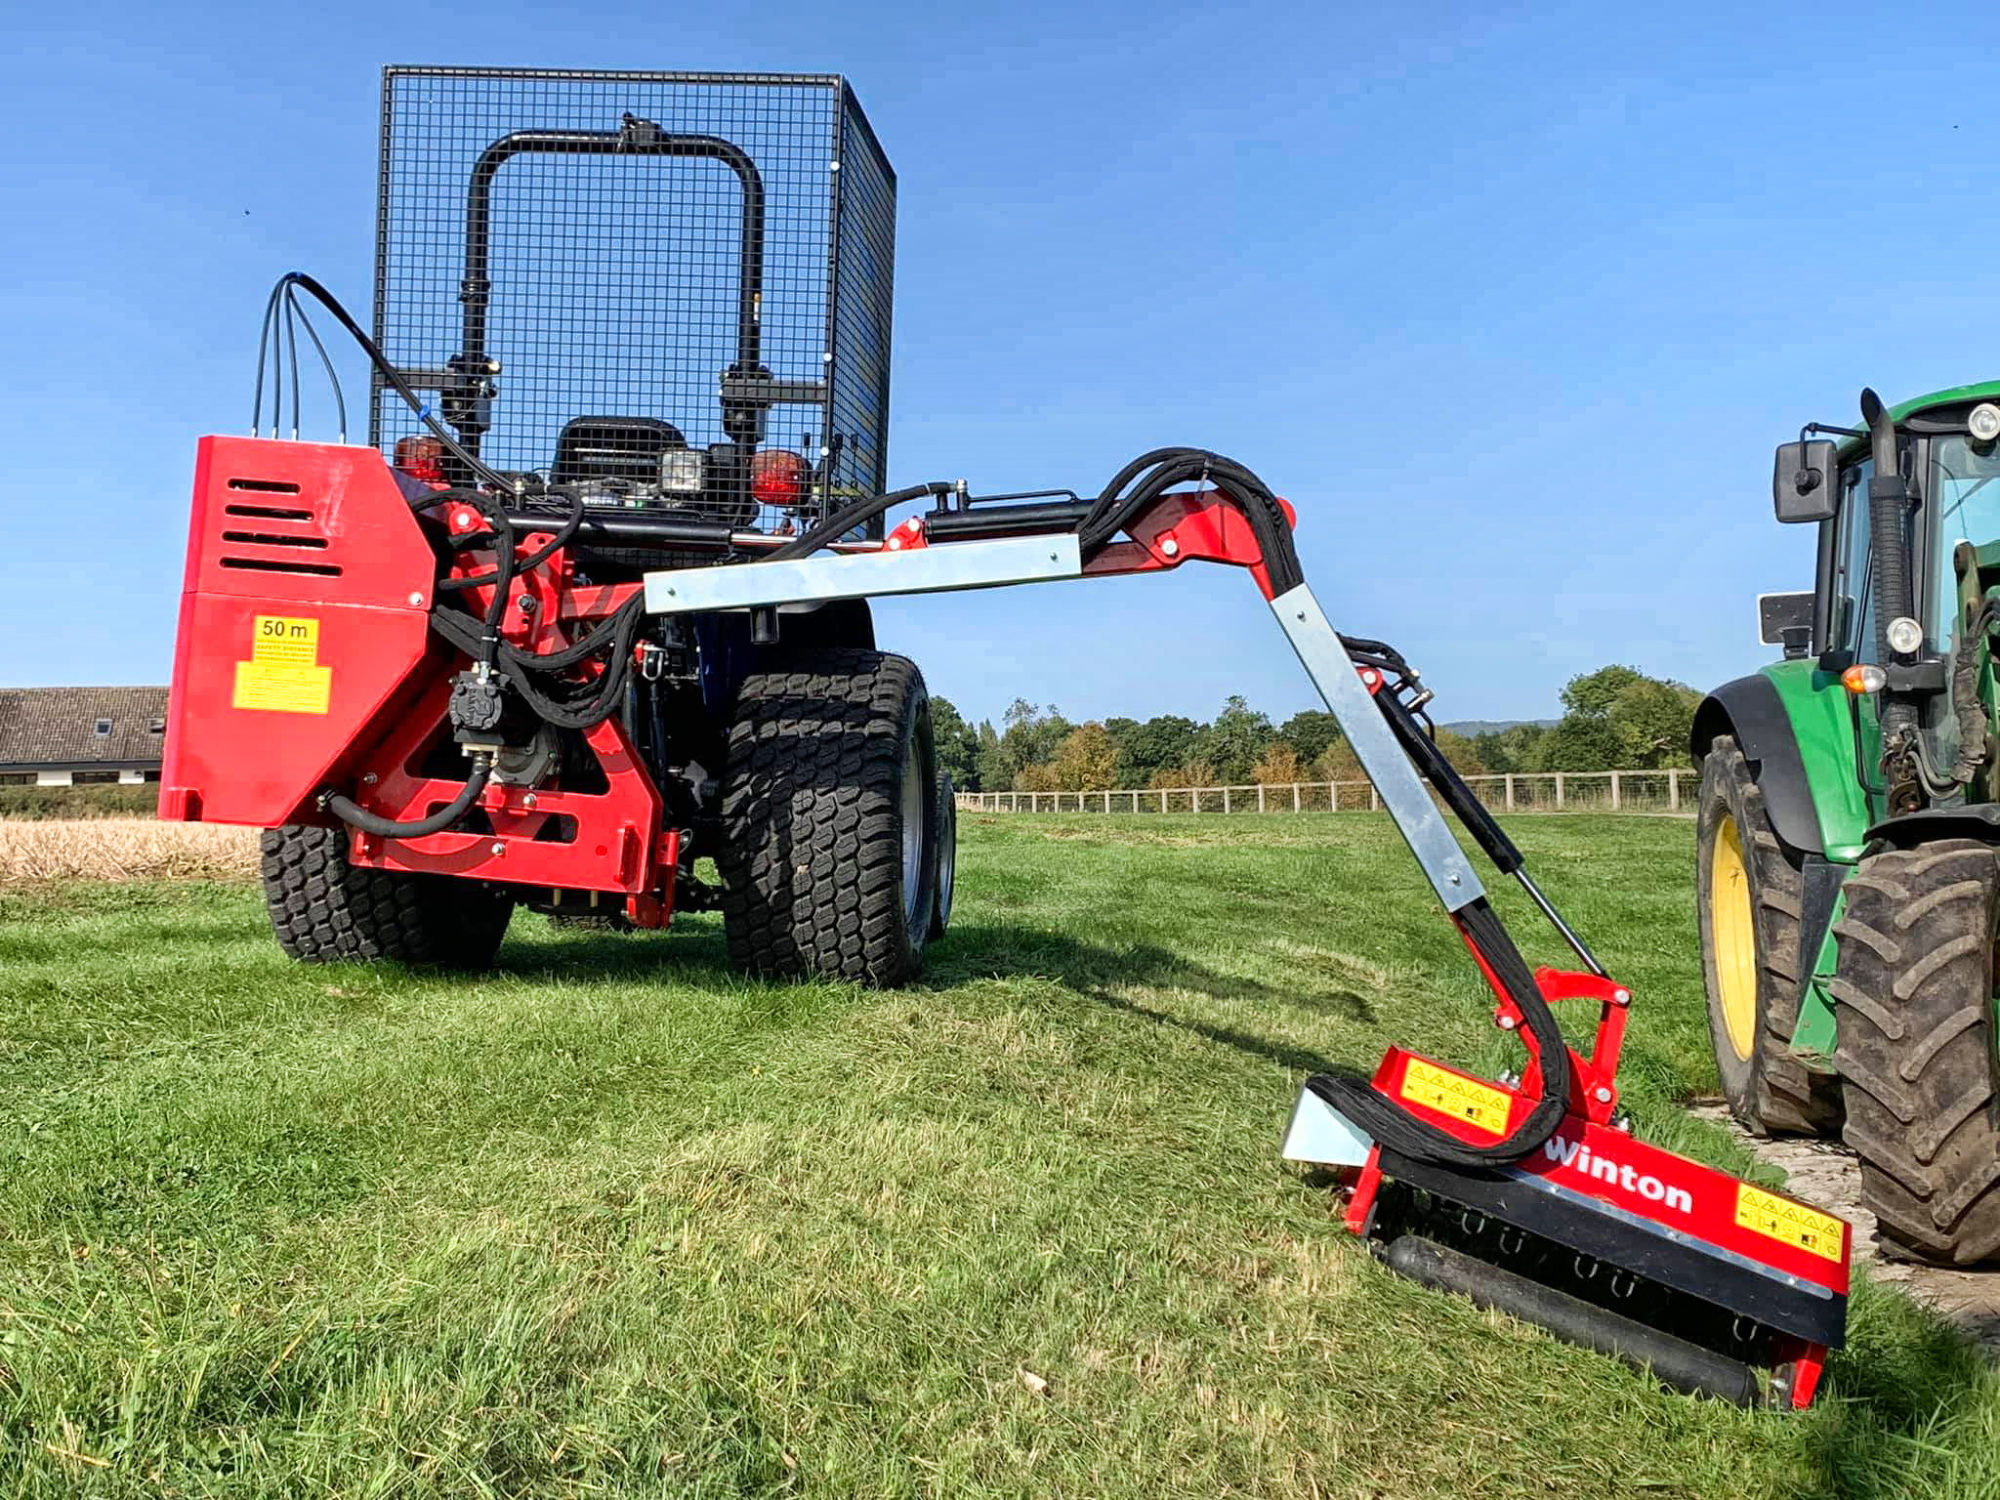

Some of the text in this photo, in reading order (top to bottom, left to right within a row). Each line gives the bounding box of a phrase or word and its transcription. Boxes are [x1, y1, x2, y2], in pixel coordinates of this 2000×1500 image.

[263, 621, 307, 638] 50 m
[1544, 1135, 1693, 1214] Winton
